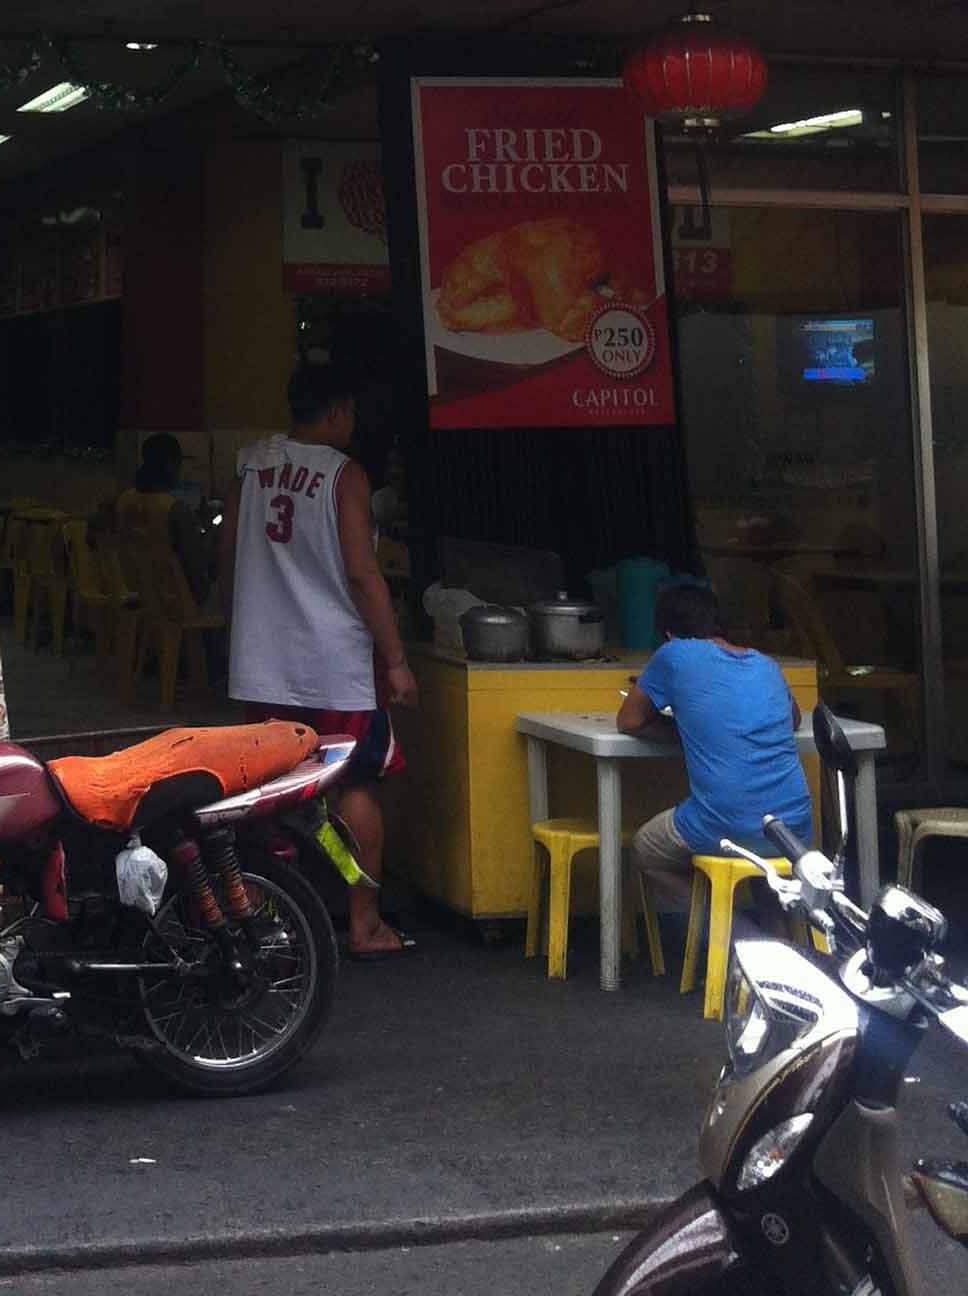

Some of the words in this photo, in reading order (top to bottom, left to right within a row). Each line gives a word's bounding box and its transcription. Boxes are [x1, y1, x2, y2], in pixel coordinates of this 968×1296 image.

[463, 127, 603, 163] FRIED
[440, 162, 632, 194] CHICKEN
[601, 349, 641, 363] ONLY
[571, 387, 663, 408] CAPITOL
[257, 461, 326, 500] WADE
[265, 494, 295, 544] 3
